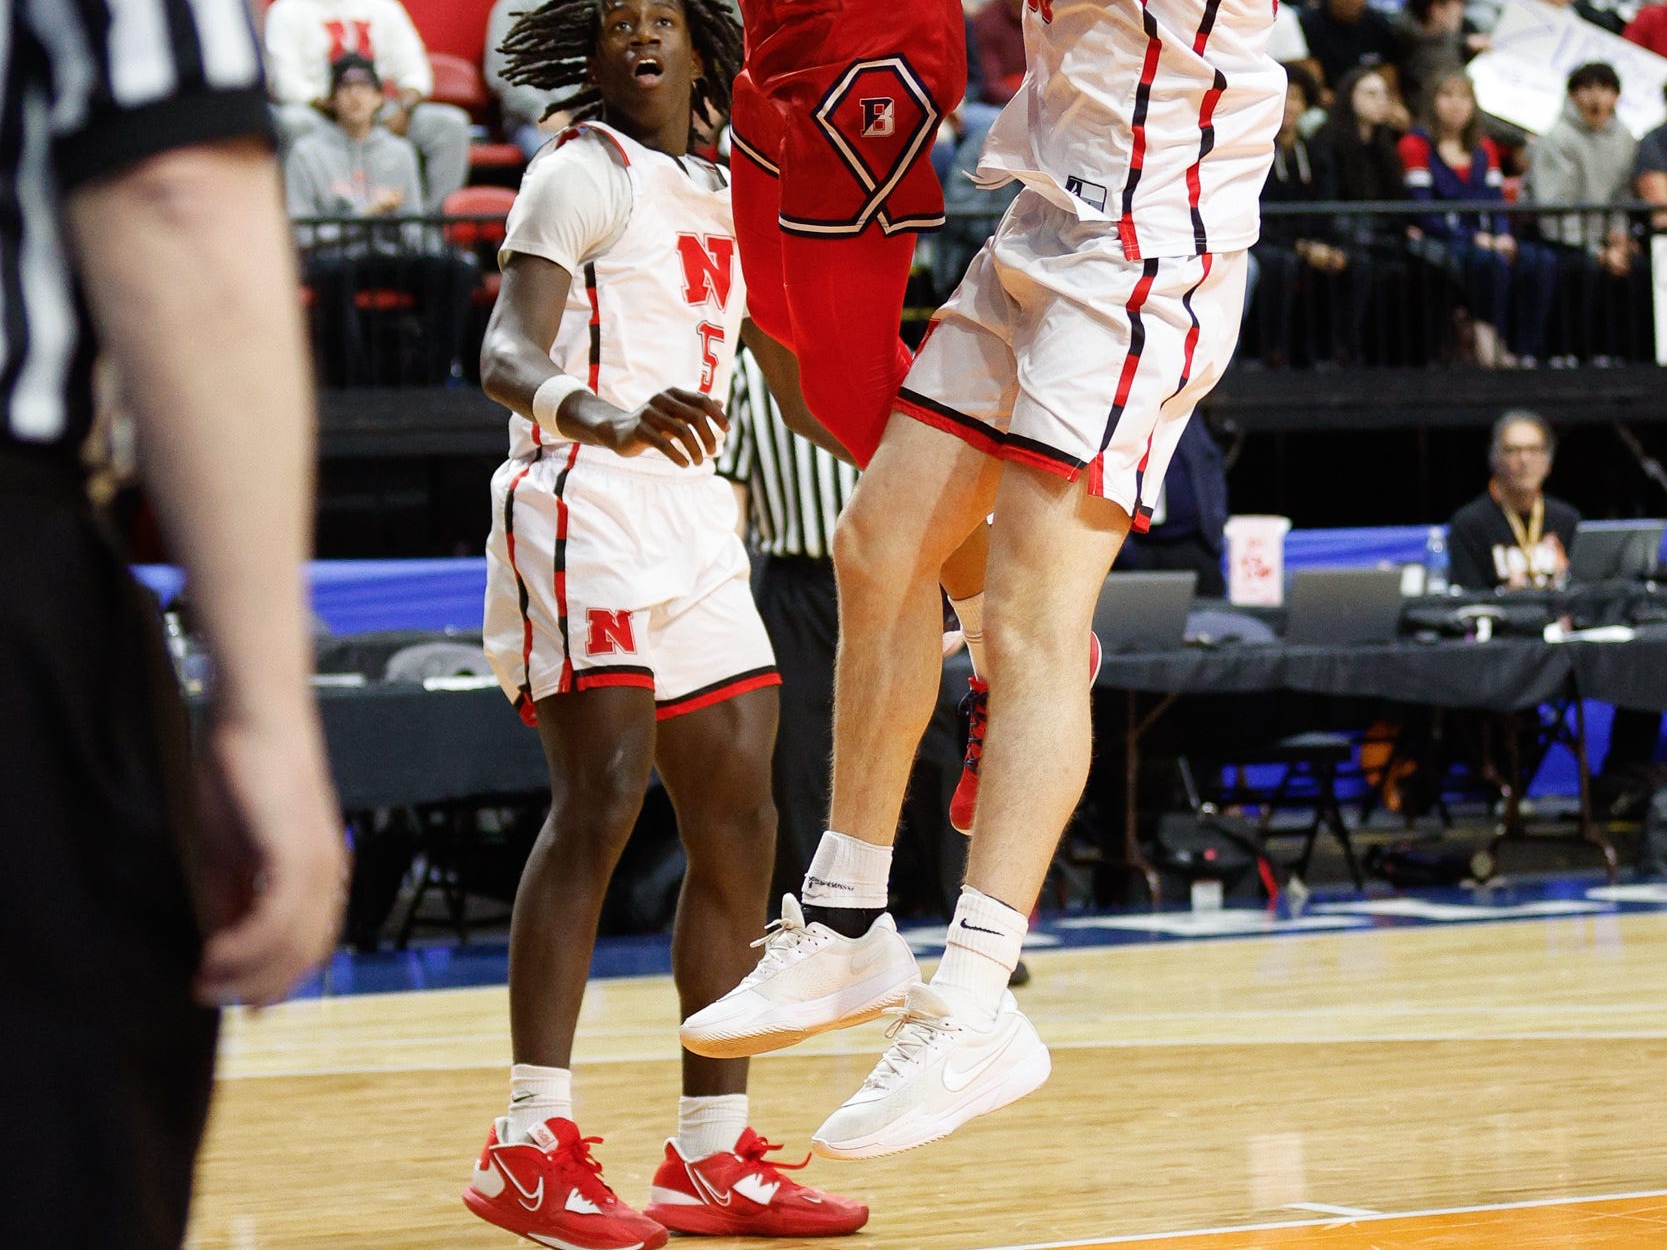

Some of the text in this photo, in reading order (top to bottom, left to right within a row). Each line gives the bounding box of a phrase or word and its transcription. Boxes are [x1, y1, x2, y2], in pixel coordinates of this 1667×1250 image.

[859, 96, 896, 139] B
[676, 231, 736, 314] N
[696, 320, 726, 396] 5
[585, 607, 638, 658] N
